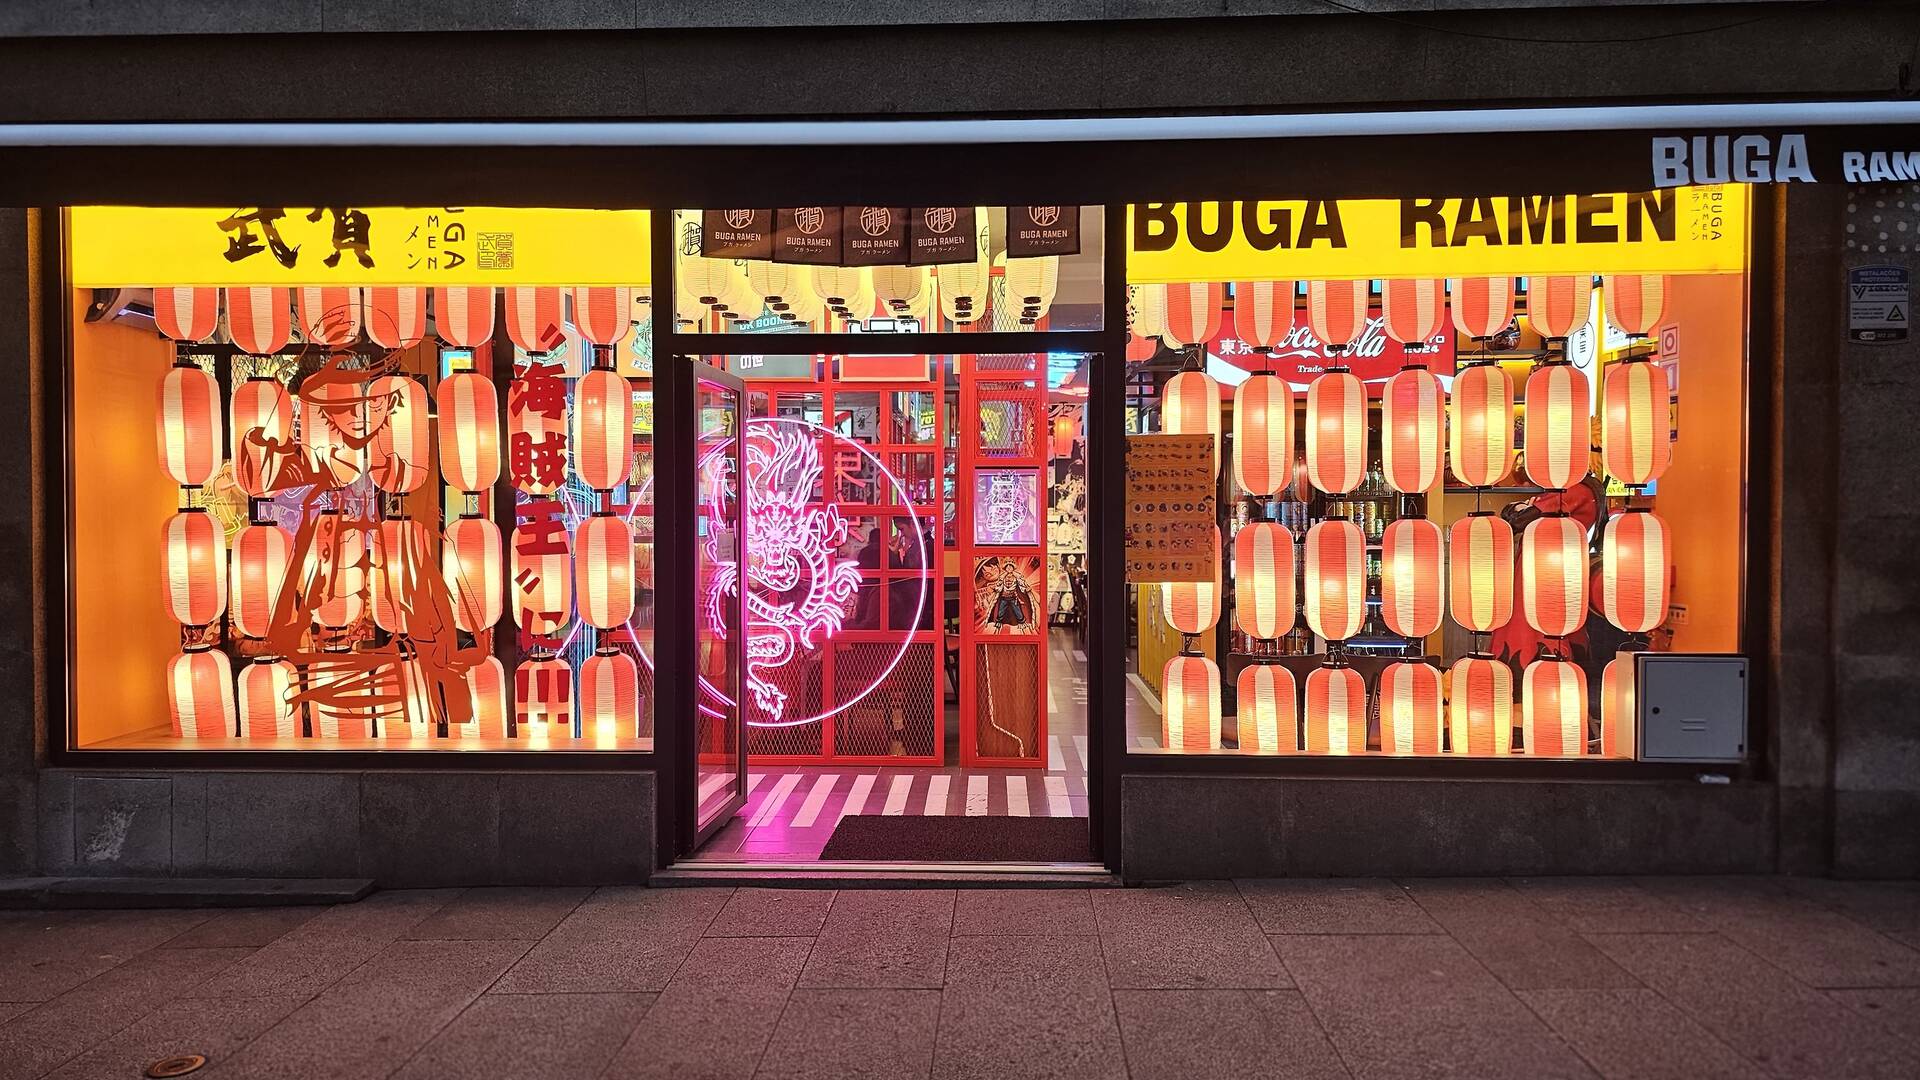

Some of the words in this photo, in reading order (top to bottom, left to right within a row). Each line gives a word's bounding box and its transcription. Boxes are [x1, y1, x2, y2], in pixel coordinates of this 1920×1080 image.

[1652, 134, 1818, 188] BUGA
[1843, 151, 1920, 183] RAM
[1134, 200, 1348, 253] BUGA
[1400, 188, 1677, 249] RAMEN
[1711, 193, 1722, 241] BUGA
[714, 231, 735, 240] BUGA
[736, 233, 761, 241] RAMEN
[1020, 230, 1041, 239] BUGA
[1042, 229, 1068, 238] RAMEN
[786, 236, 806, 246] BUGA
[807, 238, 832, 247] RAMEN
[852, 240, 872, 249] BUGA
[873, 240, 899, 248] RAMEN
[917, 238, 938, 247] BUGA
[939, 236, 965, 245] RAMEN
[1267, 315, 1387, 358] ocaola
[1219, 338, 1254, 355] 東京
[633, 360, 652, 371] FIG
